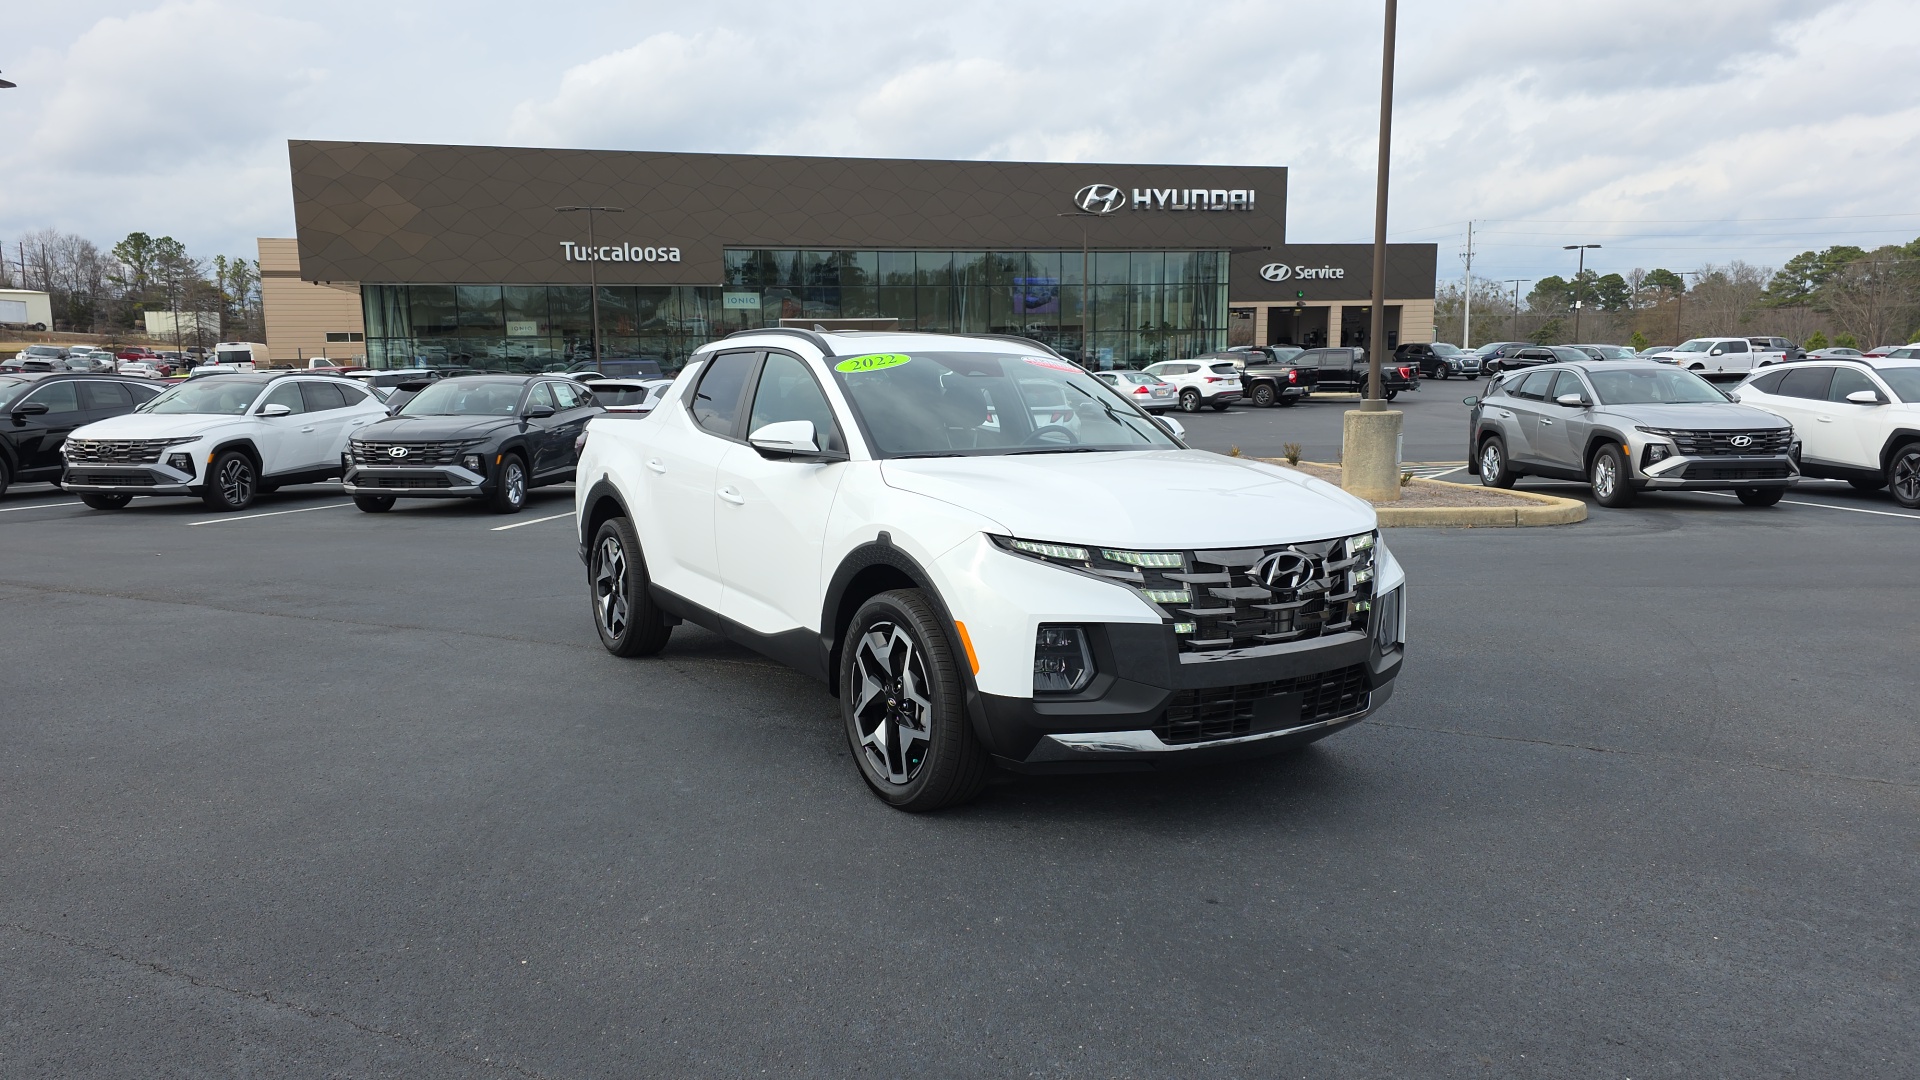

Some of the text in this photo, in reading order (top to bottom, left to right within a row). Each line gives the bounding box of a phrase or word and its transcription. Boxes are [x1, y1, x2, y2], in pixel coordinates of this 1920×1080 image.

[1131, 188, 1255, 211] HYUNDAI
[559, 241, 681, 262] Tuscaloosa
[1294, 264, 1344, 280] Service
[850, 354, 897, 371] 2022
